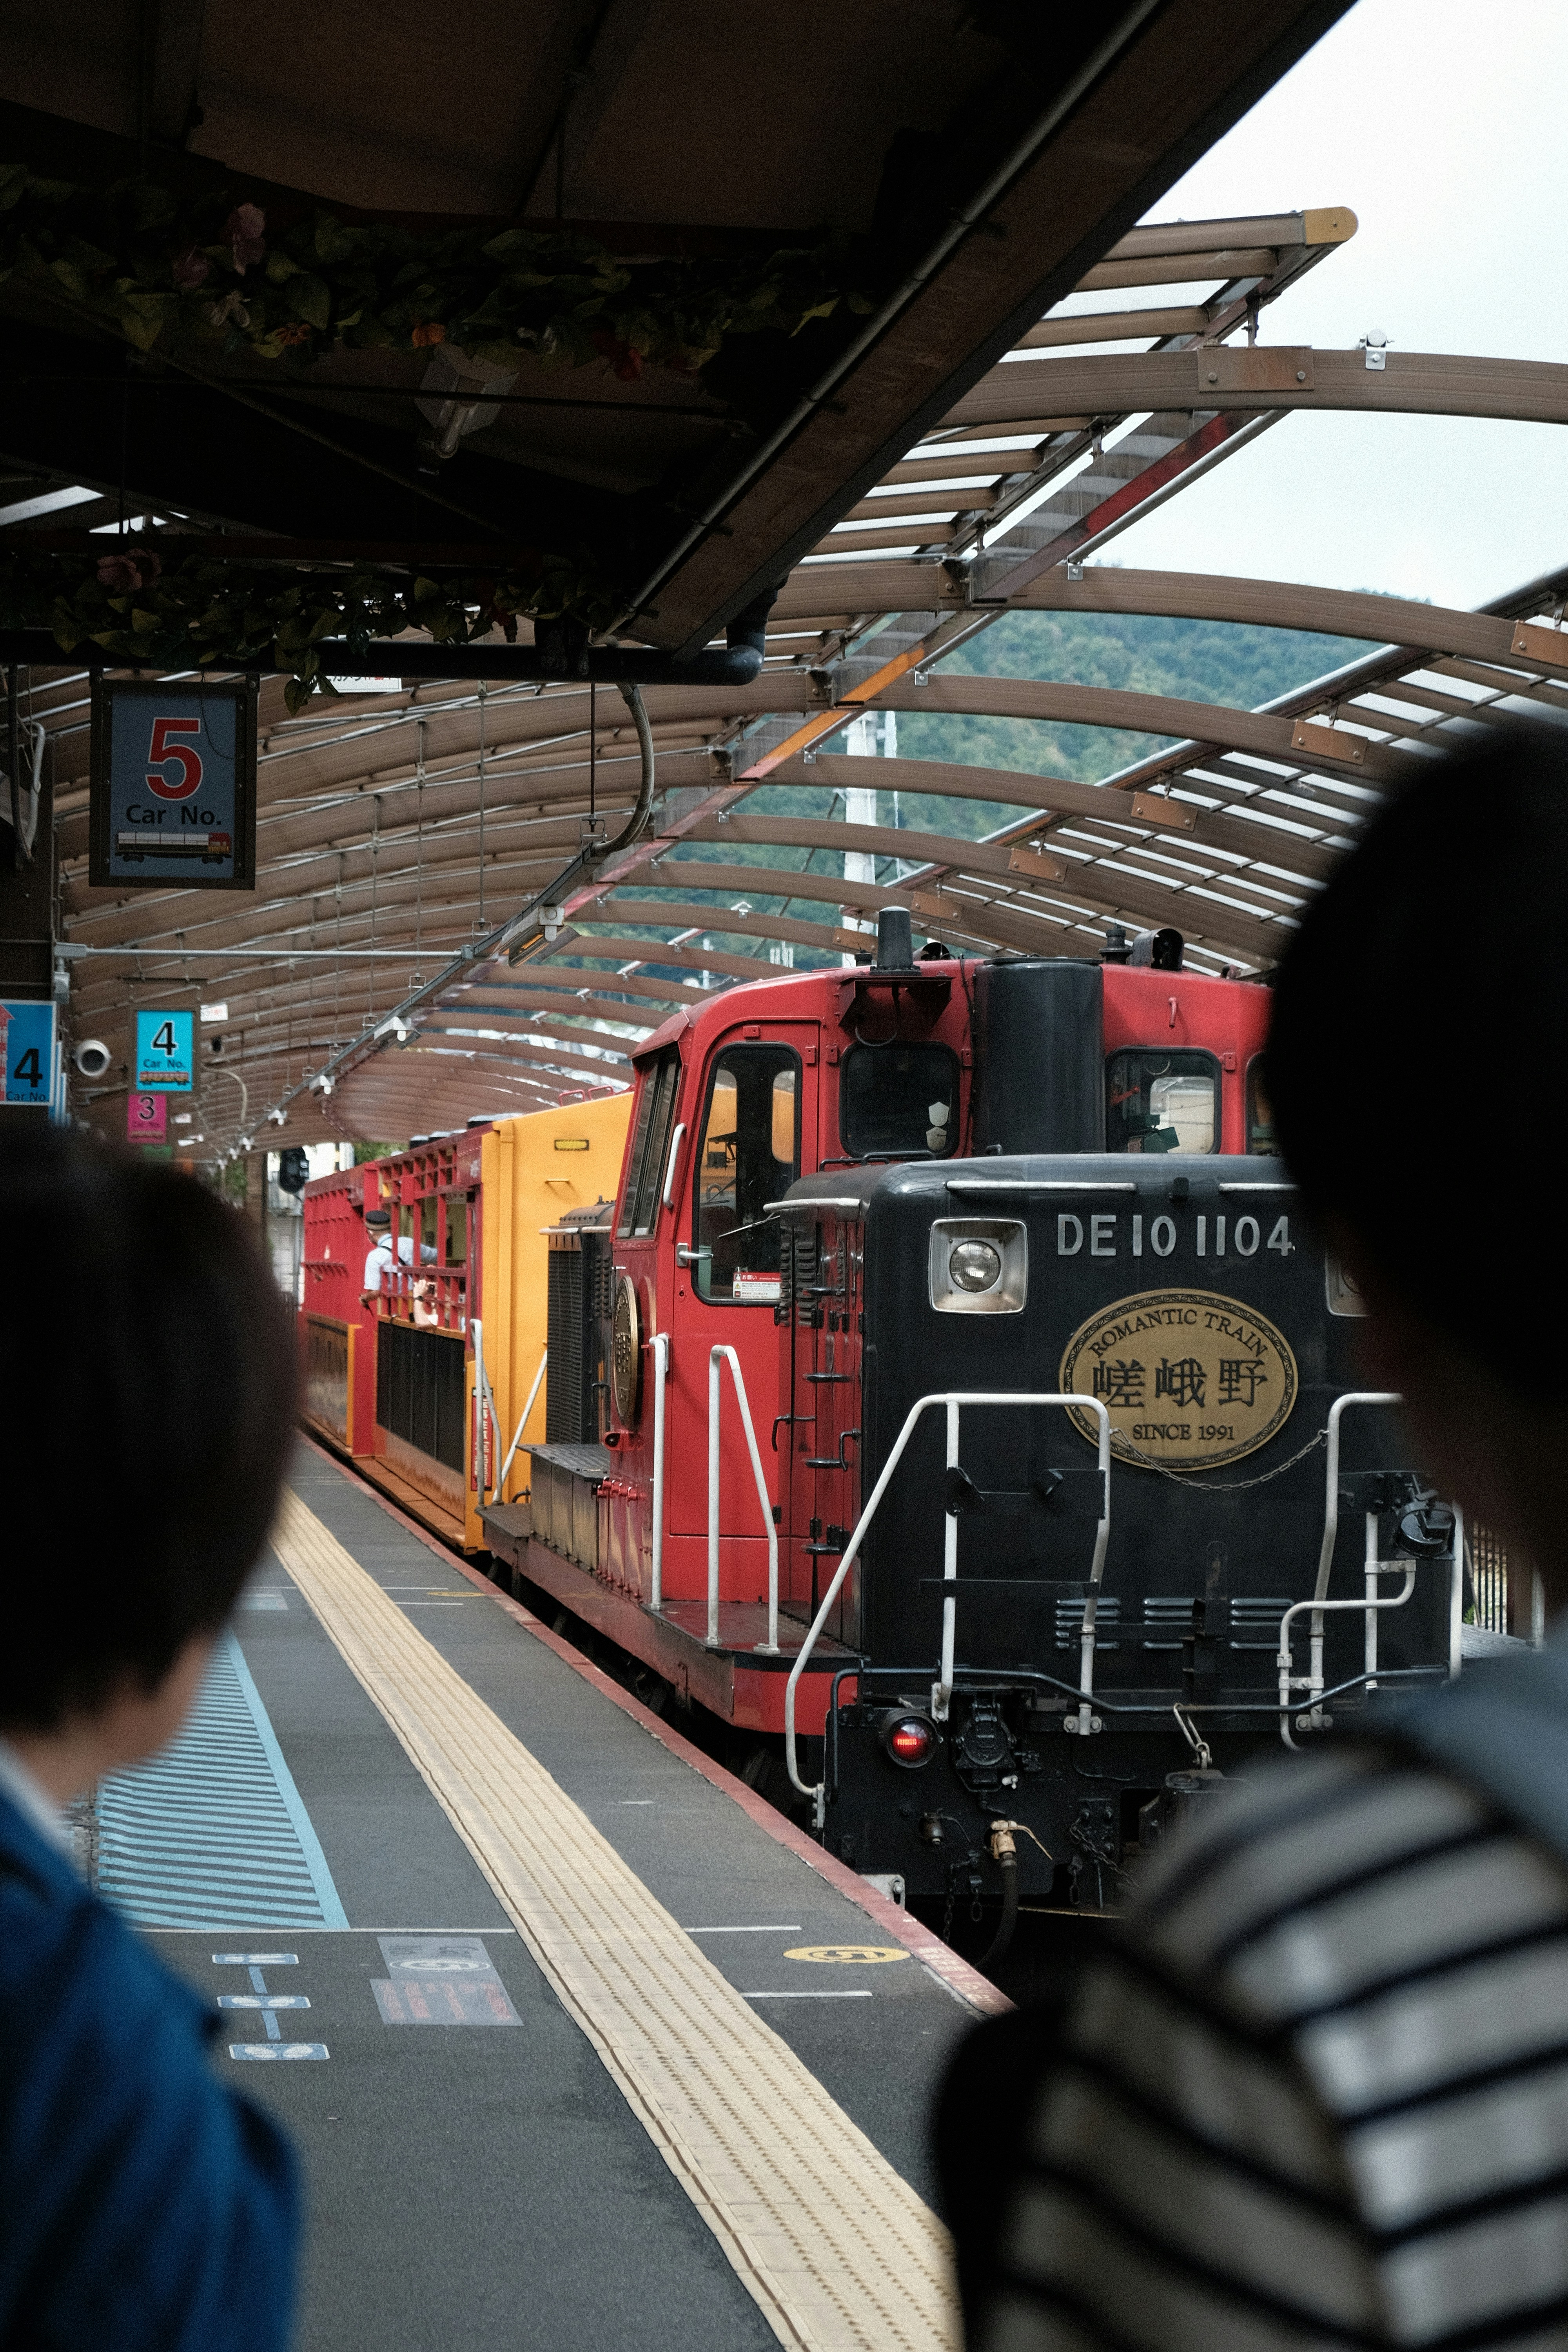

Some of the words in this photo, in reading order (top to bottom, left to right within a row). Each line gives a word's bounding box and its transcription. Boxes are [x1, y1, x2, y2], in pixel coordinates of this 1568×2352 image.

[145, 717, 203, 800] 5
[126, 804, 167, 824] Car
[181, 805, 221, 825] No.
[151, 1020, 179, 1057] 4
[14, 1048, 43, 1088] 4
[142, 1058, 162, 1069] Car
[6, 1091, 25, 1101] Car
[29, 1092, 49, 1102] No.
[138, 1096, 155, 1121] 3
[1197, 1216, 1292, 1256] 1104
[1088, 1308, 1197, 1358] ROMANTIC
[1205, 1312, 1268, 1357] TRAIN
[1092, 1357, 1268, 1408] 嵯峨野
[1132, 1424, 1191, 1441] SINCE
[1198, 1425, 1235, 1441] 1991
